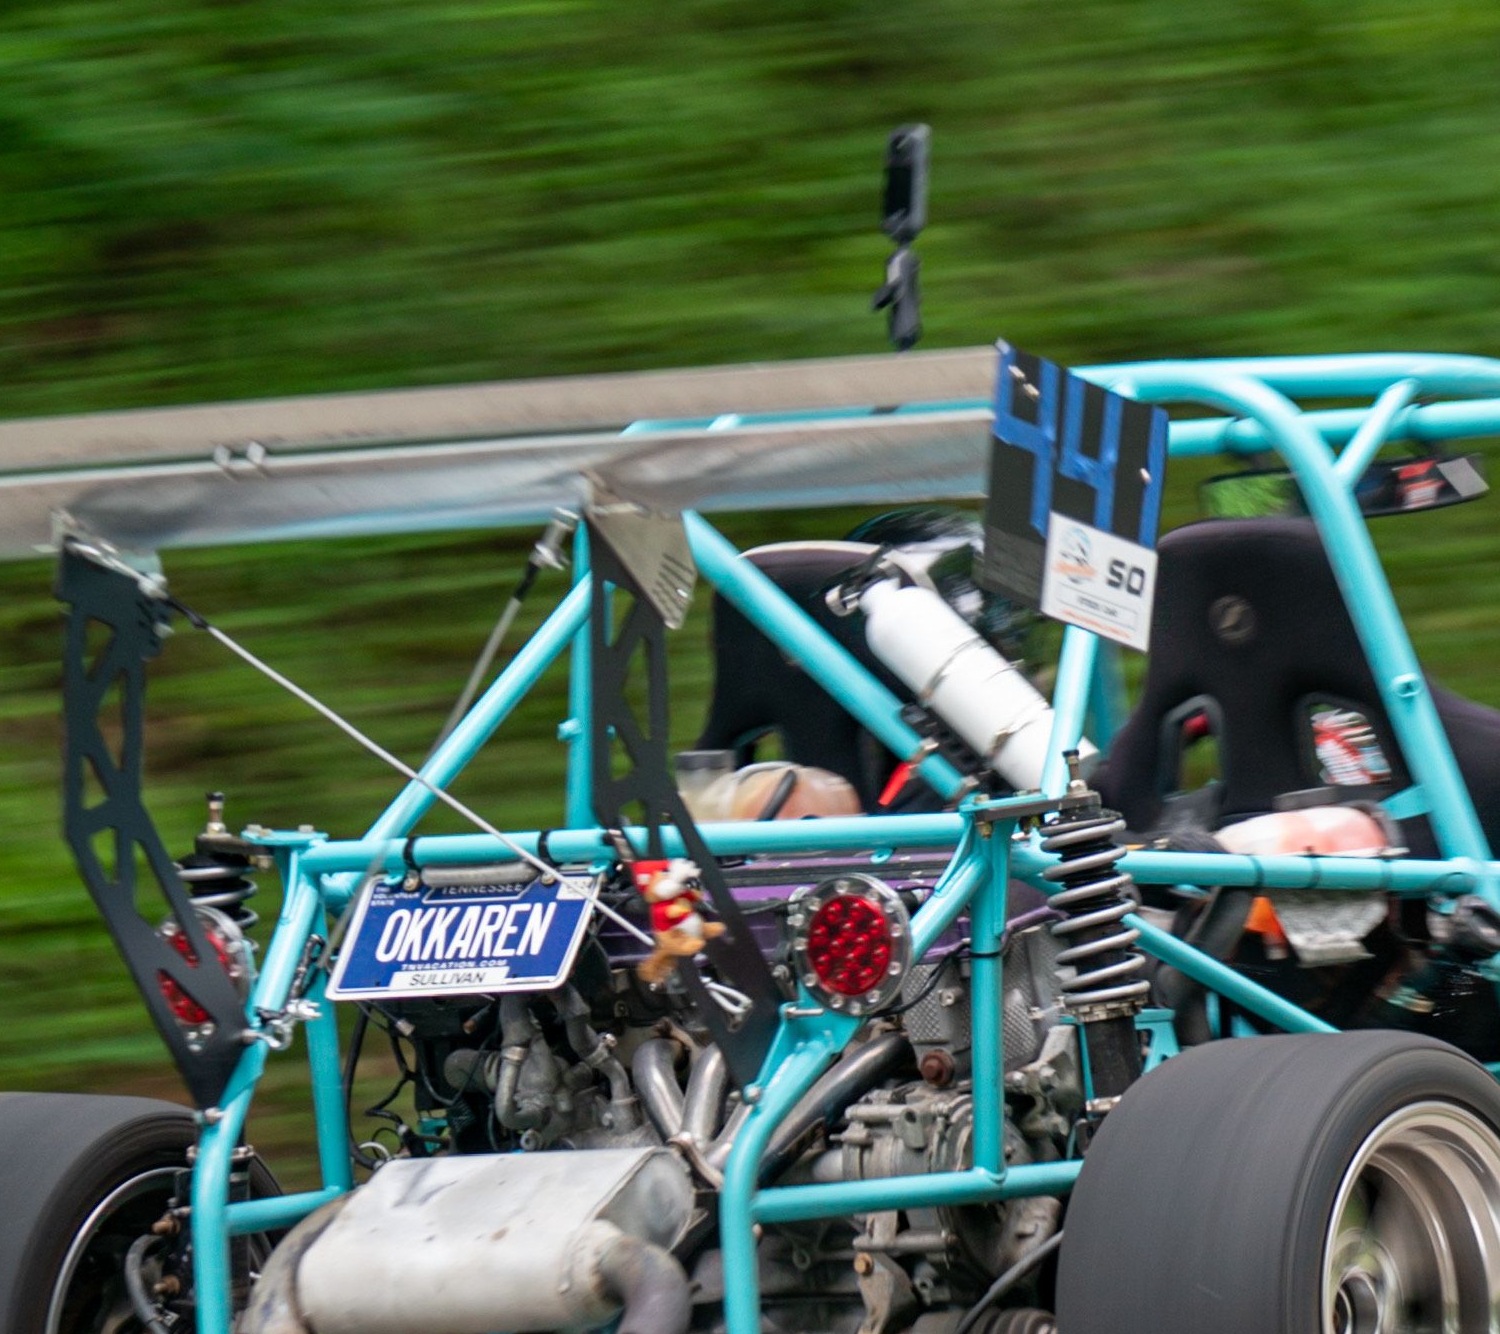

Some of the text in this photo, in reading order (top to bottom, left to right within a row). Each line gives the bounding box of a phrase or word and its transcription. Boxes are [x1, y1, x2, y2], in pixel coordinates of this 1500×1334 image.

[375, 902, 557, 963] OKKAREN
[401, 959, 508, 971] TNVACATION.COM
[409, 972, 485, 986] SULLIVAN
